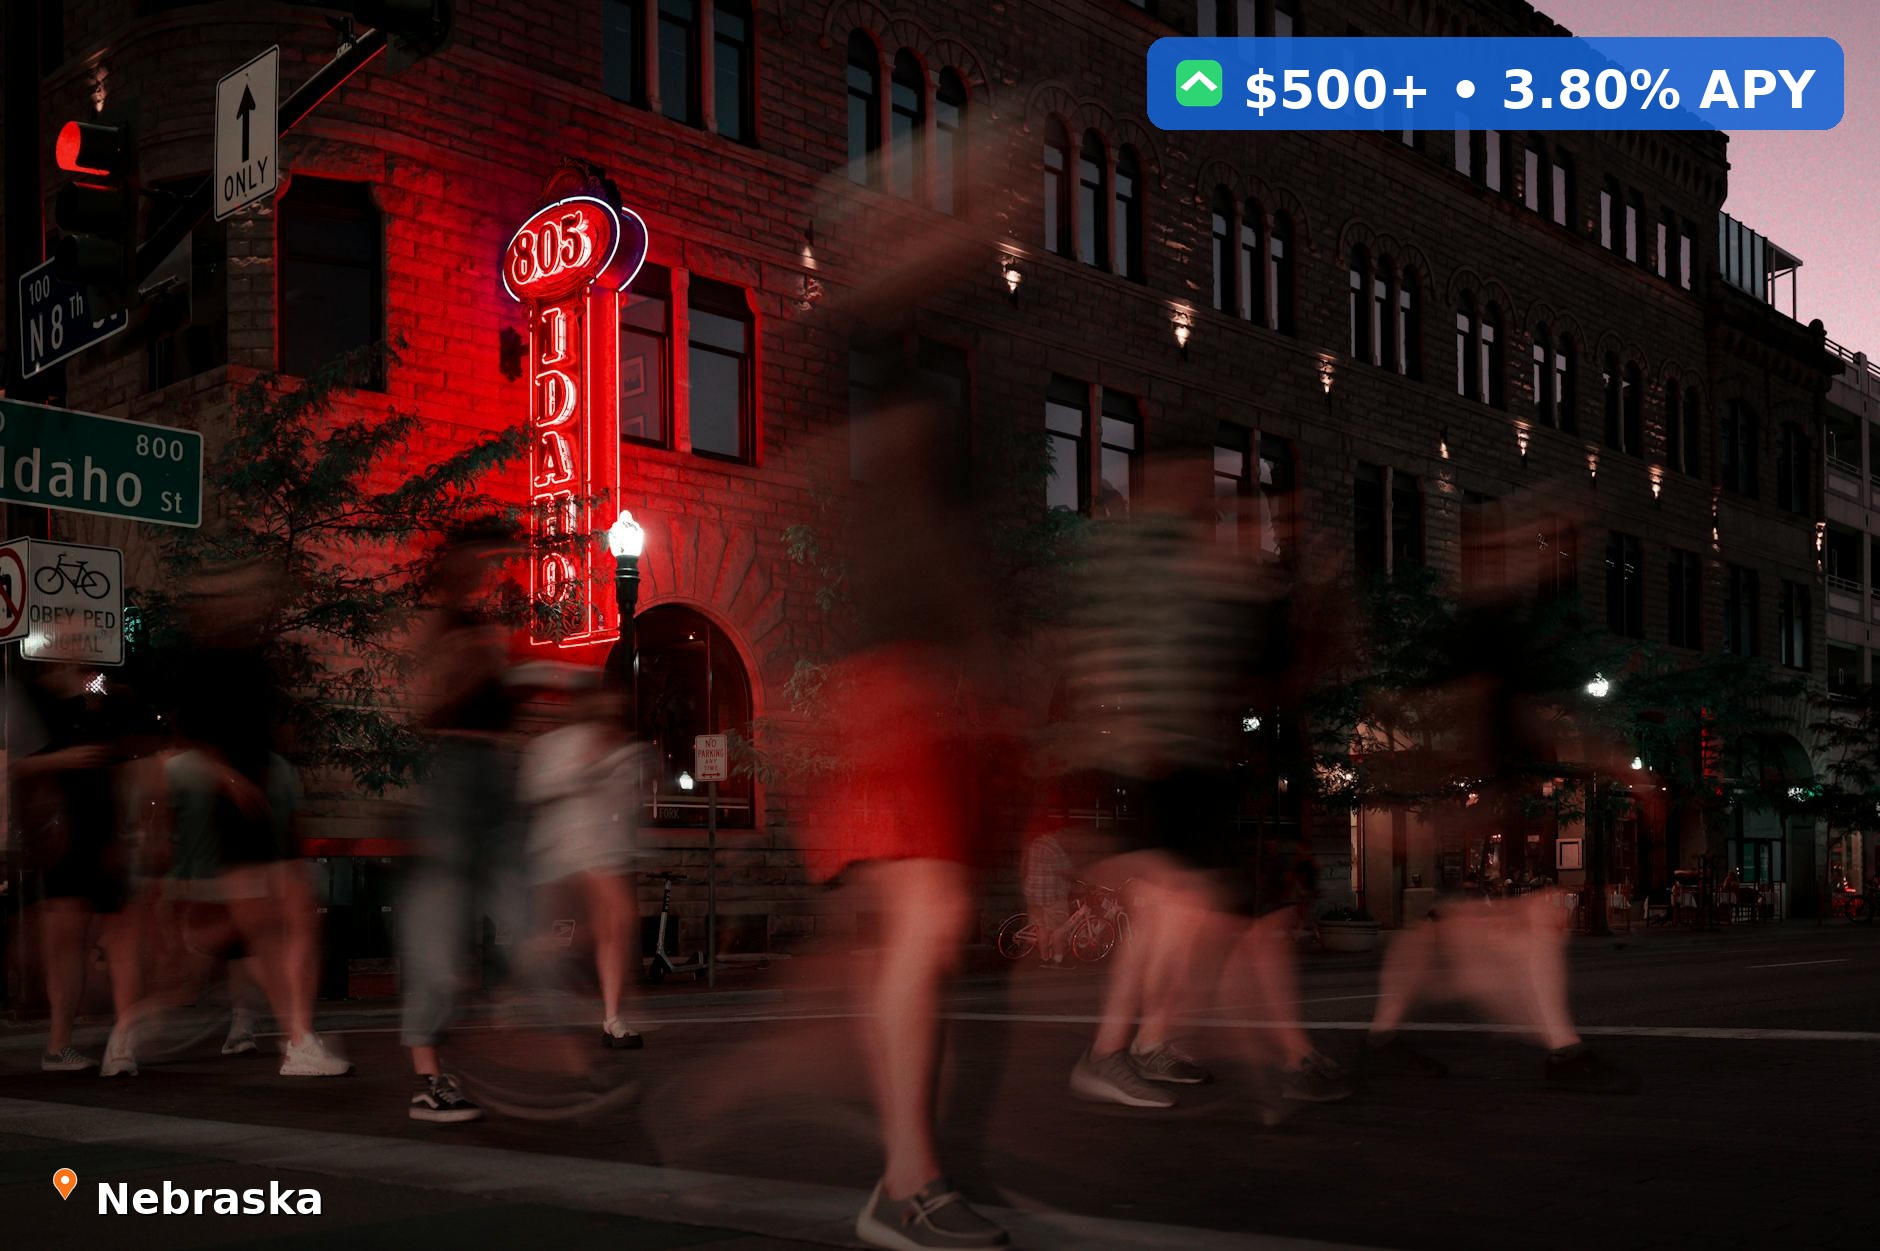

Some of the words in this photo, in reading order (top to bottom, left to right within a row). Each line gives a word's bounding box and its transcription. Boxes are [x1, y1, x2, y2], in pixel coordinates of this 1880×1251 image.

[224, 156, 268, 202] ONLY
[512, 210, 592, 285] 805
[29, 274, 50, 306] 100
[30, 311, 44, 362] N
[136, 433, 184, 462] 800
[533, 307, 577, 607] IDAHO
[30, 604, 76, 625] OBEY
[83, 609, 116, 629] PED
[43, 632, 104, 653] SIGNAL
[697, 748, 725, 758] PARKING
[705, 739, 717, 748] NO
[659, 807, 680, 820] FORK
